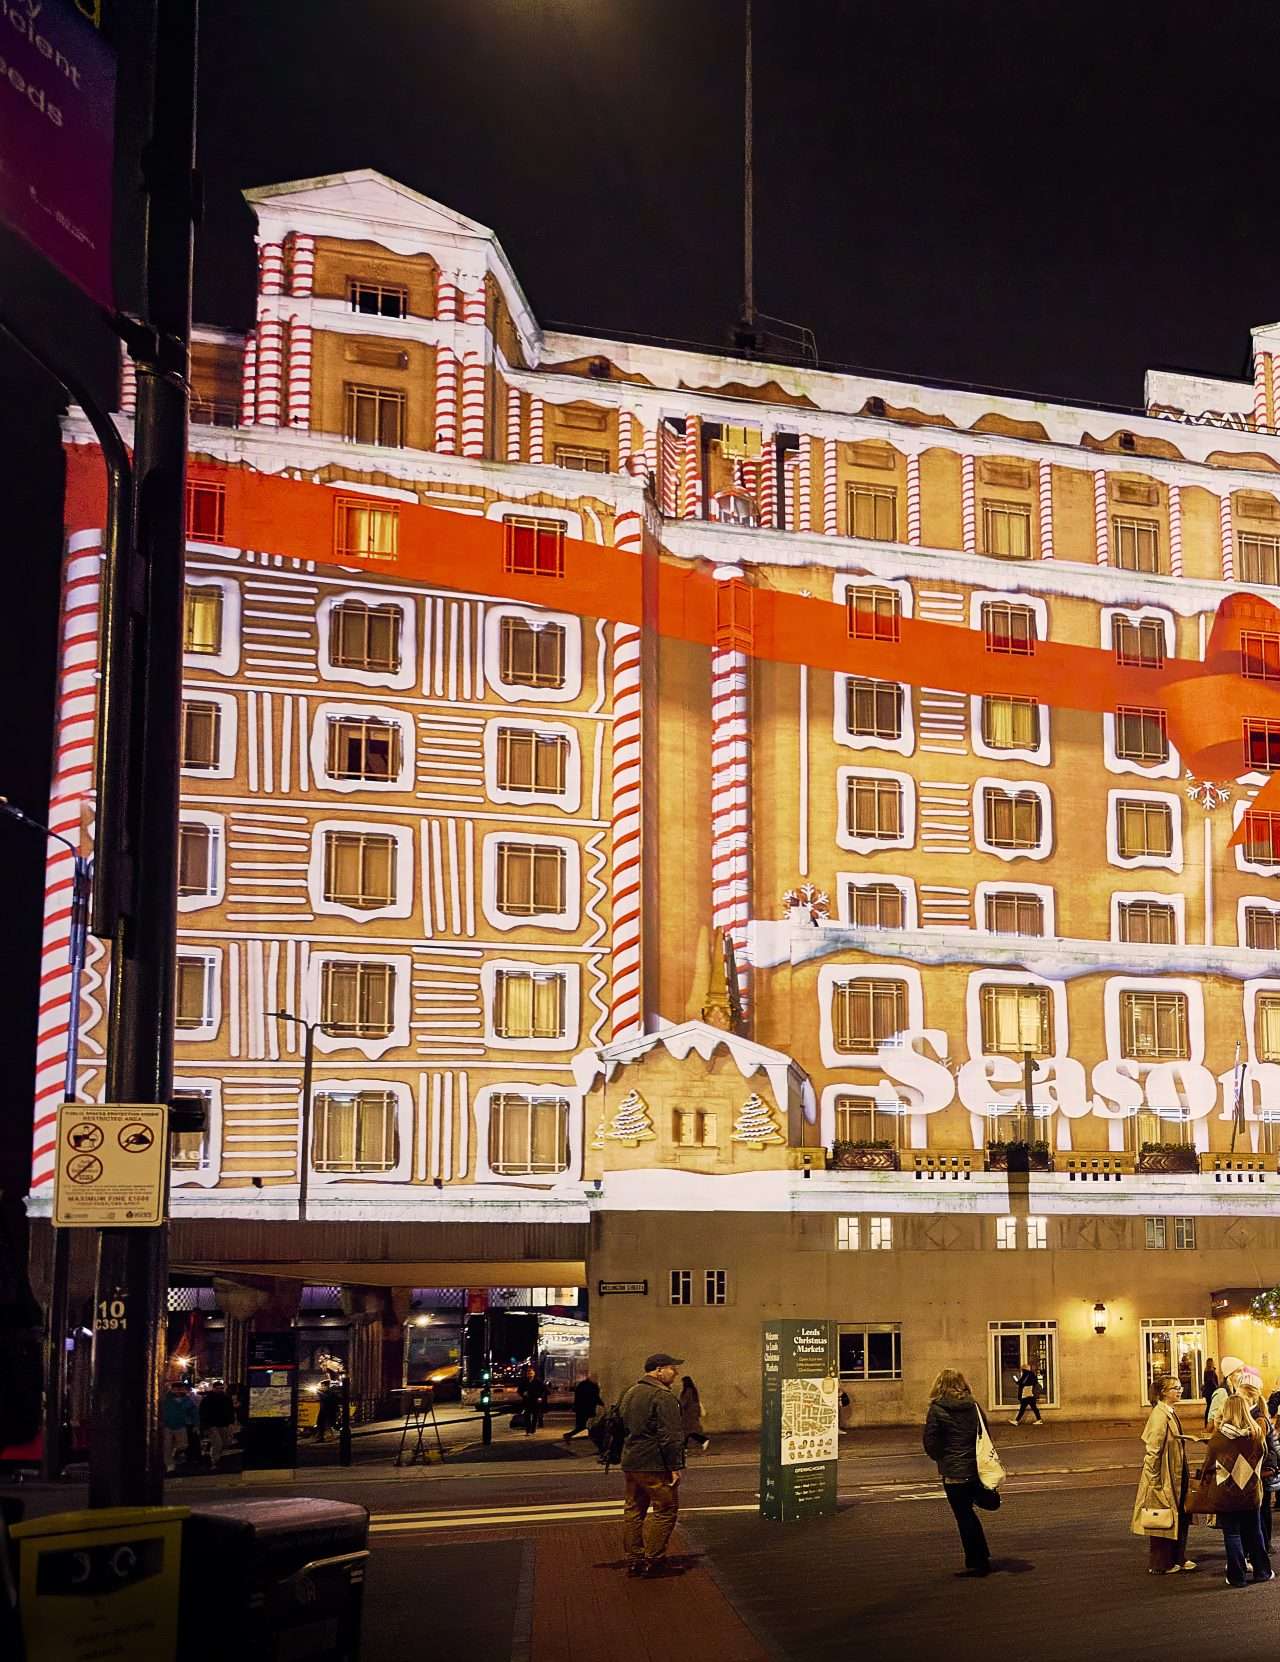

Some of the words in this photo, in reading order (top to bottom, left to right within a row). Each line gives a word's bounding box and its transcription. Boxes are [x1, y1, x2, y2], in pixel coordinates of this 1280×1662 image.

[99, 1301, 125, 1318] 10
[801, 1328, 821, 1336] Leeds
[797, 1345, 825, 1353] Markets
